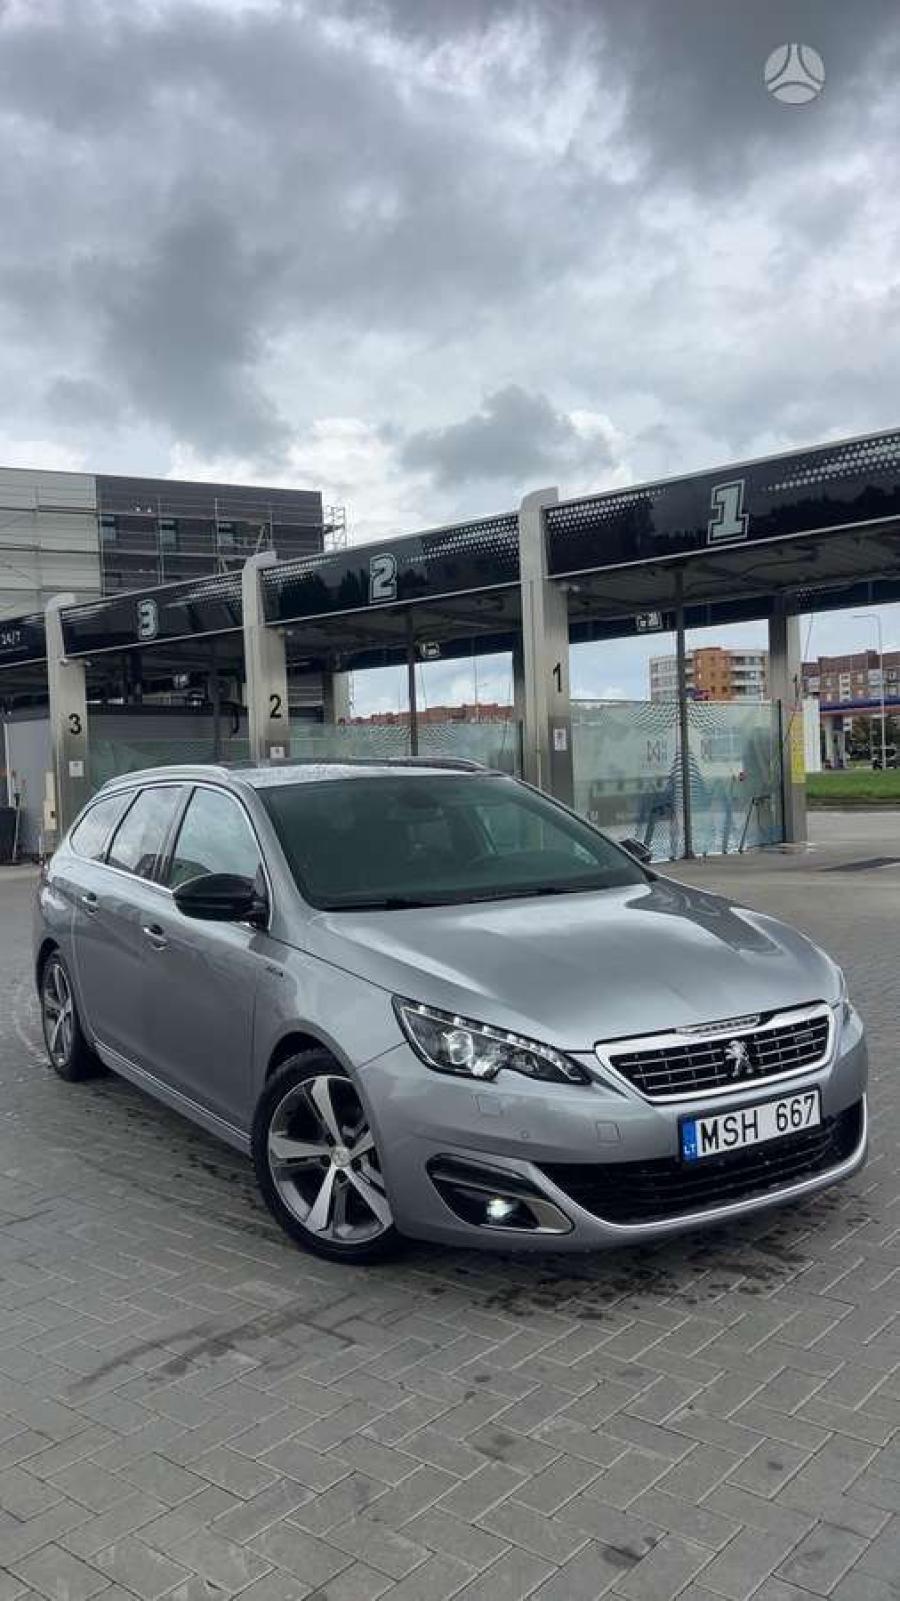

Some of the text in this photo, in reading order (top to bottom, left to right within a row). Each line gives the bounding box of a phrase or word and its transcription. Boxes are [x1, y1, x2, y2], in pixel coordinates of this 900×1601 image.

[708, 480, 749, 544] 1
[370, 553, 397, 603] 2
[138, 599, 158, 640] 3
[553, 662, 562, 692] 1
[69, 713, 82, 735] 3
[270, 694, 282, 719] 2
[700, 1093, 815, 1153] MSH 667
[684, 1143, 696, 1154] LT
